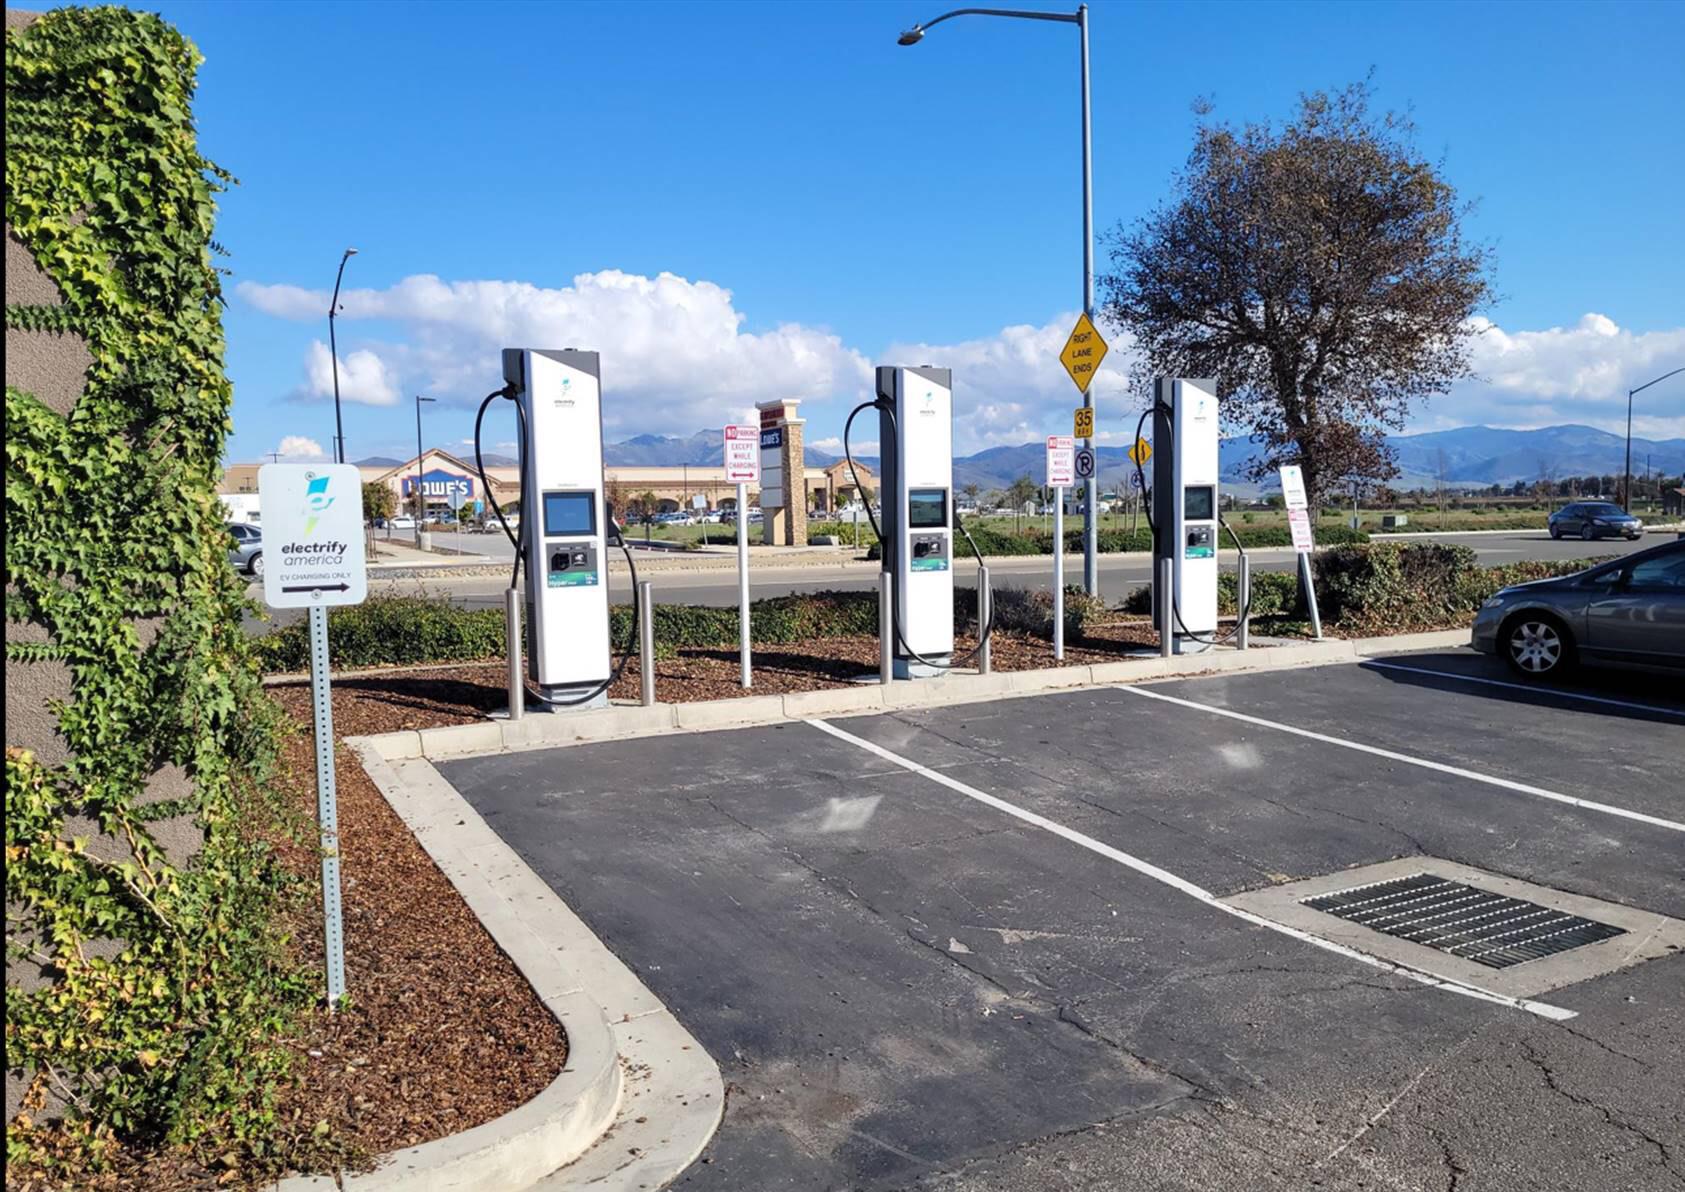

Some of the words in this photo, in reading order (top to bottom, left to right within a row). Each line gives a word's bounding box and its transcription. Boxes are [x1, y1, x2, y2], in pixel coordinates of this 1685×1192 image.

[1073, 331, 1092, 344] RIGHT
[1072, 347, 1092, 359] LANE
[1073, 362, 1092, 374] ENDS
[1076, 410, 1092, 427] 35
[731, 442, 753, 450] EXCEPT
[728, 462, 757, 470] CHARGING
[281, 541, 348, 555] electrify
[284, 553, 344, 566] america
[280, 573, 290, 582] EV
[291, 572, 331, 581] CHARGING
[331, 571, 352, 579] ONLY
